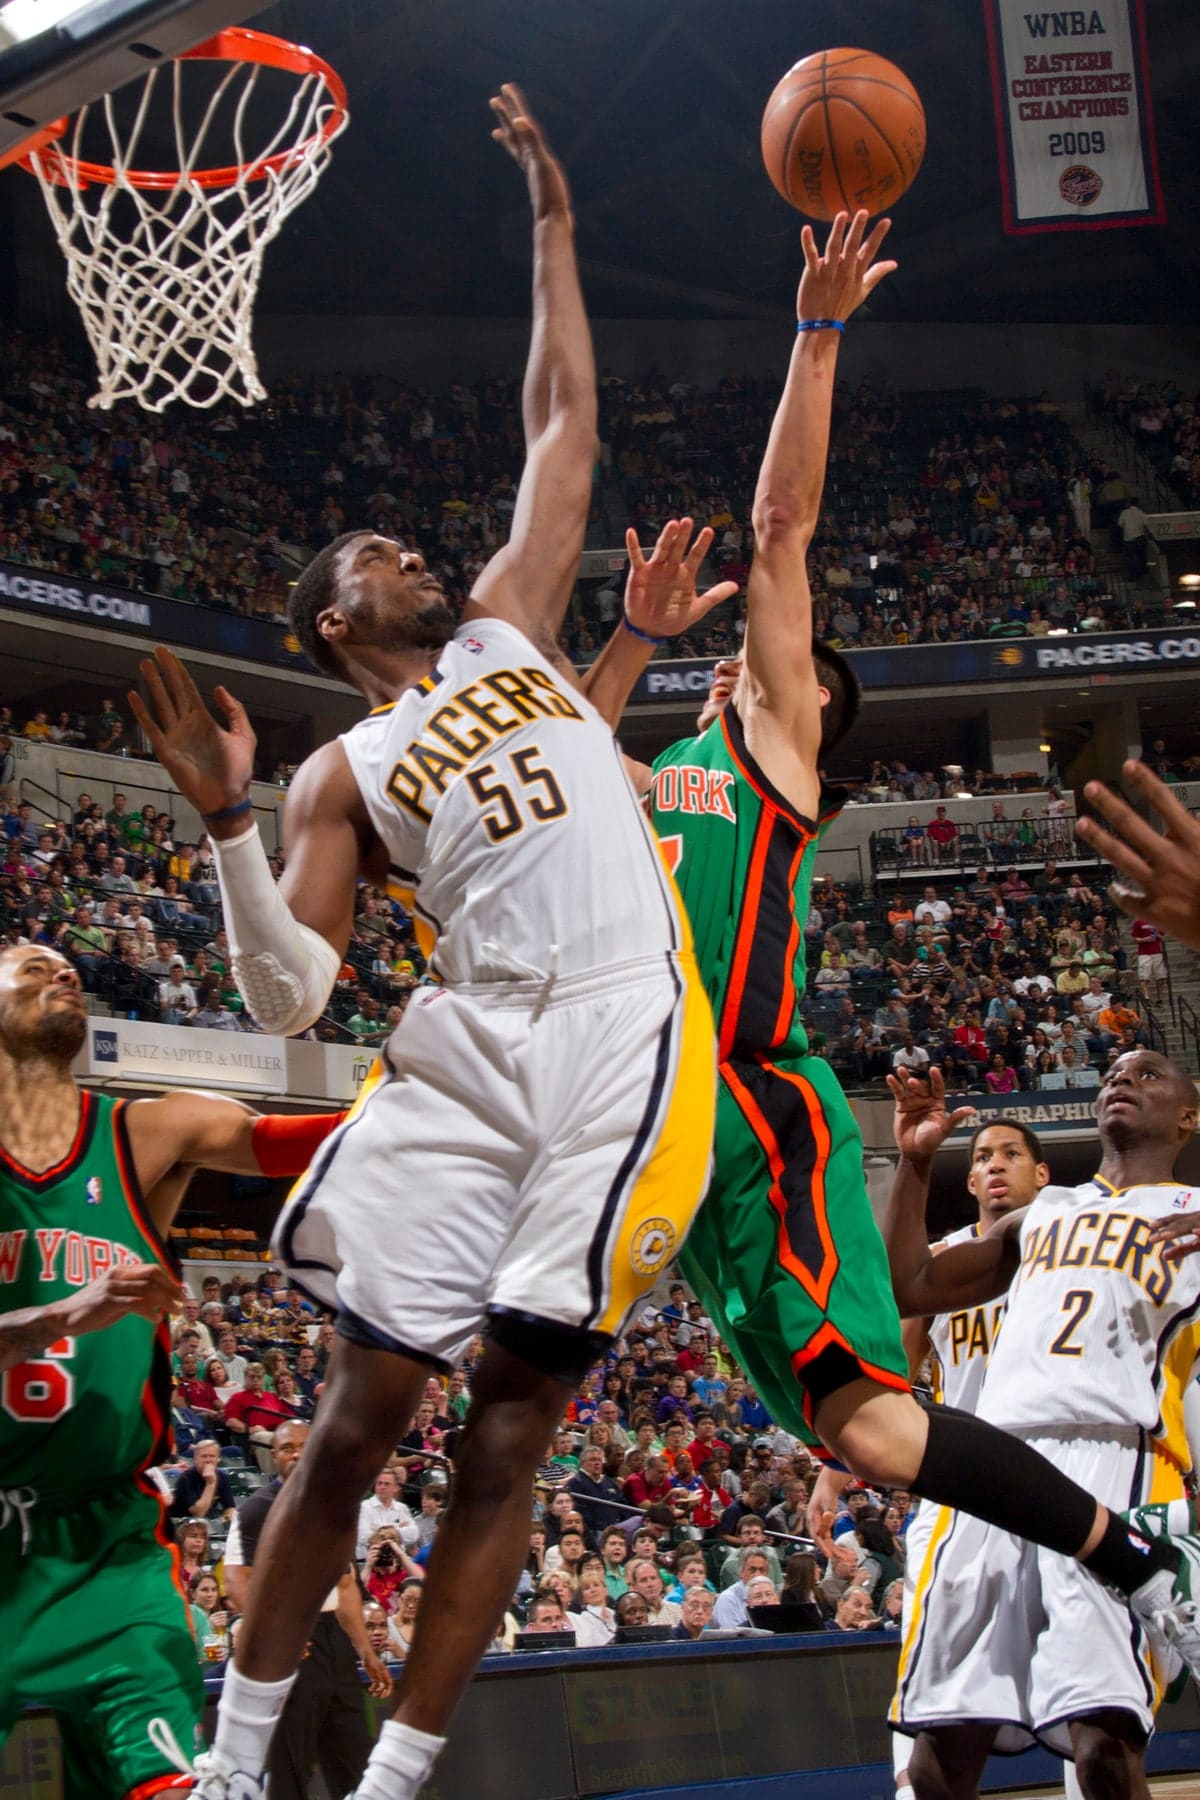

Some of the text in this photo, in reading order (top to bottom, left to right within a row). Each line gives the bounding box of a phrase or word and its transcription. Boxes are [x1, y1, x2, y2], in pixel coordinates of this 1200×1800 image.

[1024, 10, 1106, 38] WNBA
[1024, 51, 1113, 74] EASTERN
[1011, 73, 1132, 98] CONFERENCE
[1018, 97, 1129, 121] CHAMPIONS
[1049, 131, 1105, 156] 2009
[647, 670, 716, 694] PAC
[386, 667, 586, 827] PACERS
[465, 746, 568, 843] 55
[652, 764, 736, 825] ORK
[123, 1042, 281, 1072] KATZ SAPPER & MILLER
[1049, 1288, 1096, 1359] 2
